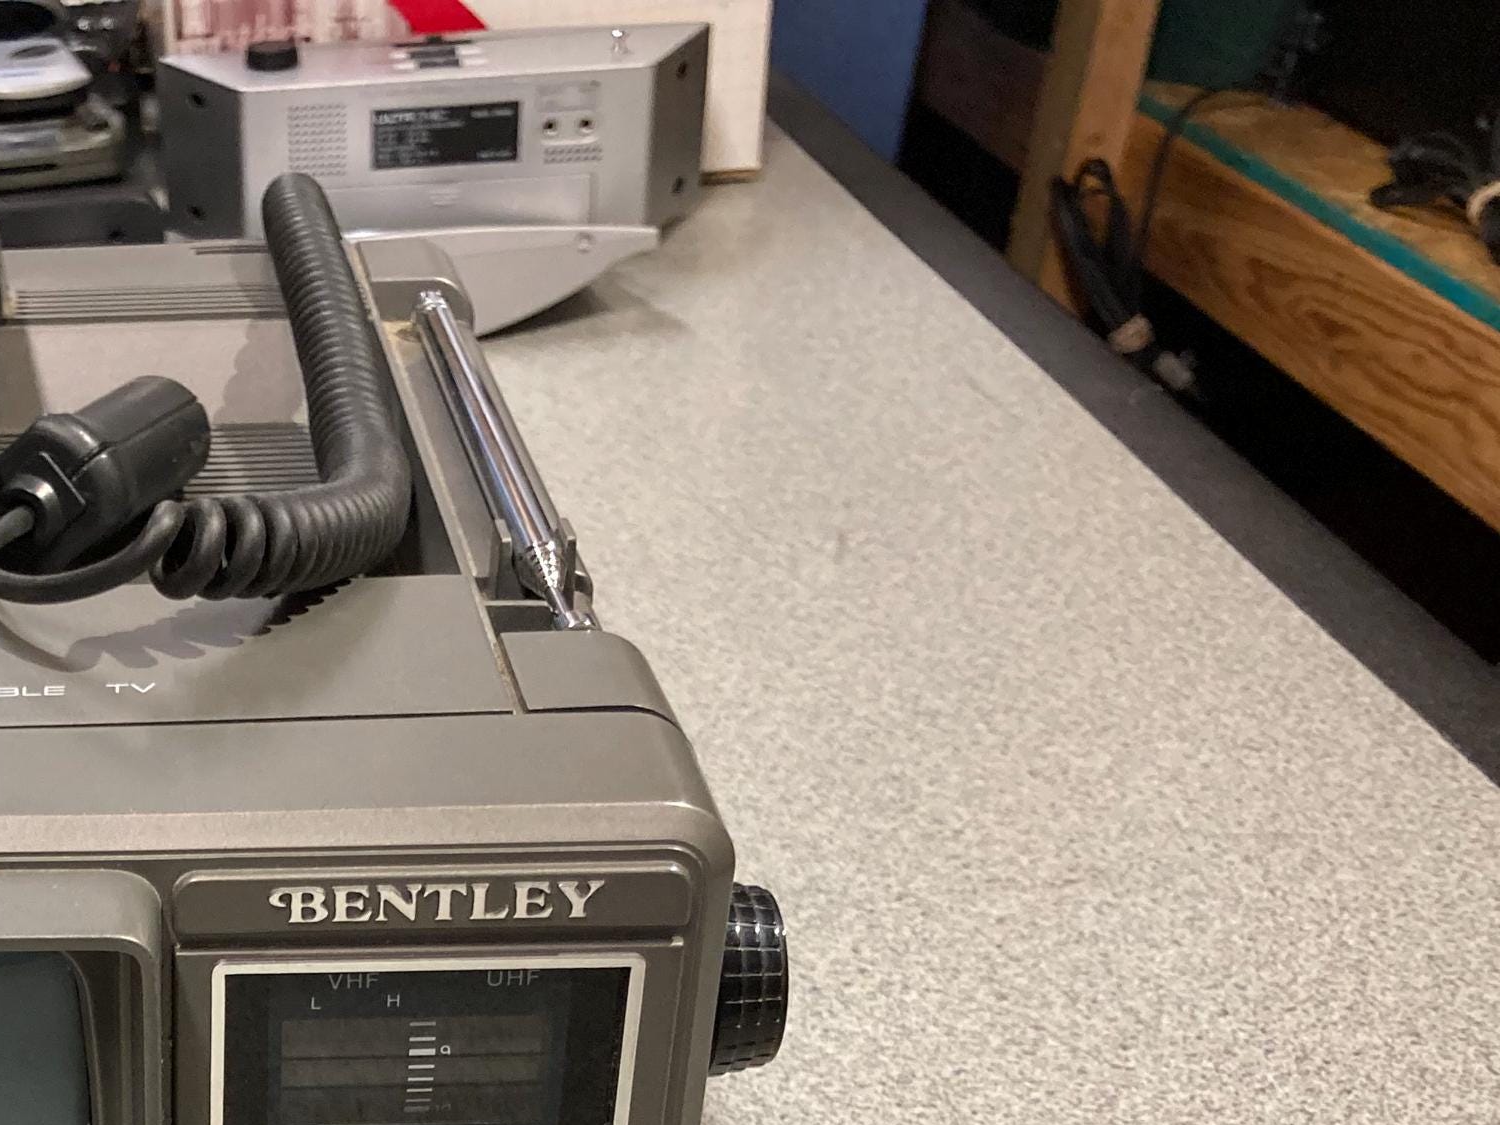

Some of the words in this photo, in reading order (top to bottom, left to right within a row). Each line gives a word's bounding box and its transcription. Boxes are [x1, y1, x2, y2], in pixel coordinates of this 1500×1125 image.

[105, 682, 158, 696] TV
[268, 880, 605, 923] BENTLEY
[328, 973, 380, 990] VHF
[486, 969, 541, 987] UHF
[311, 996, 321, 1010] L
[386, 994, 400, 1008] H
